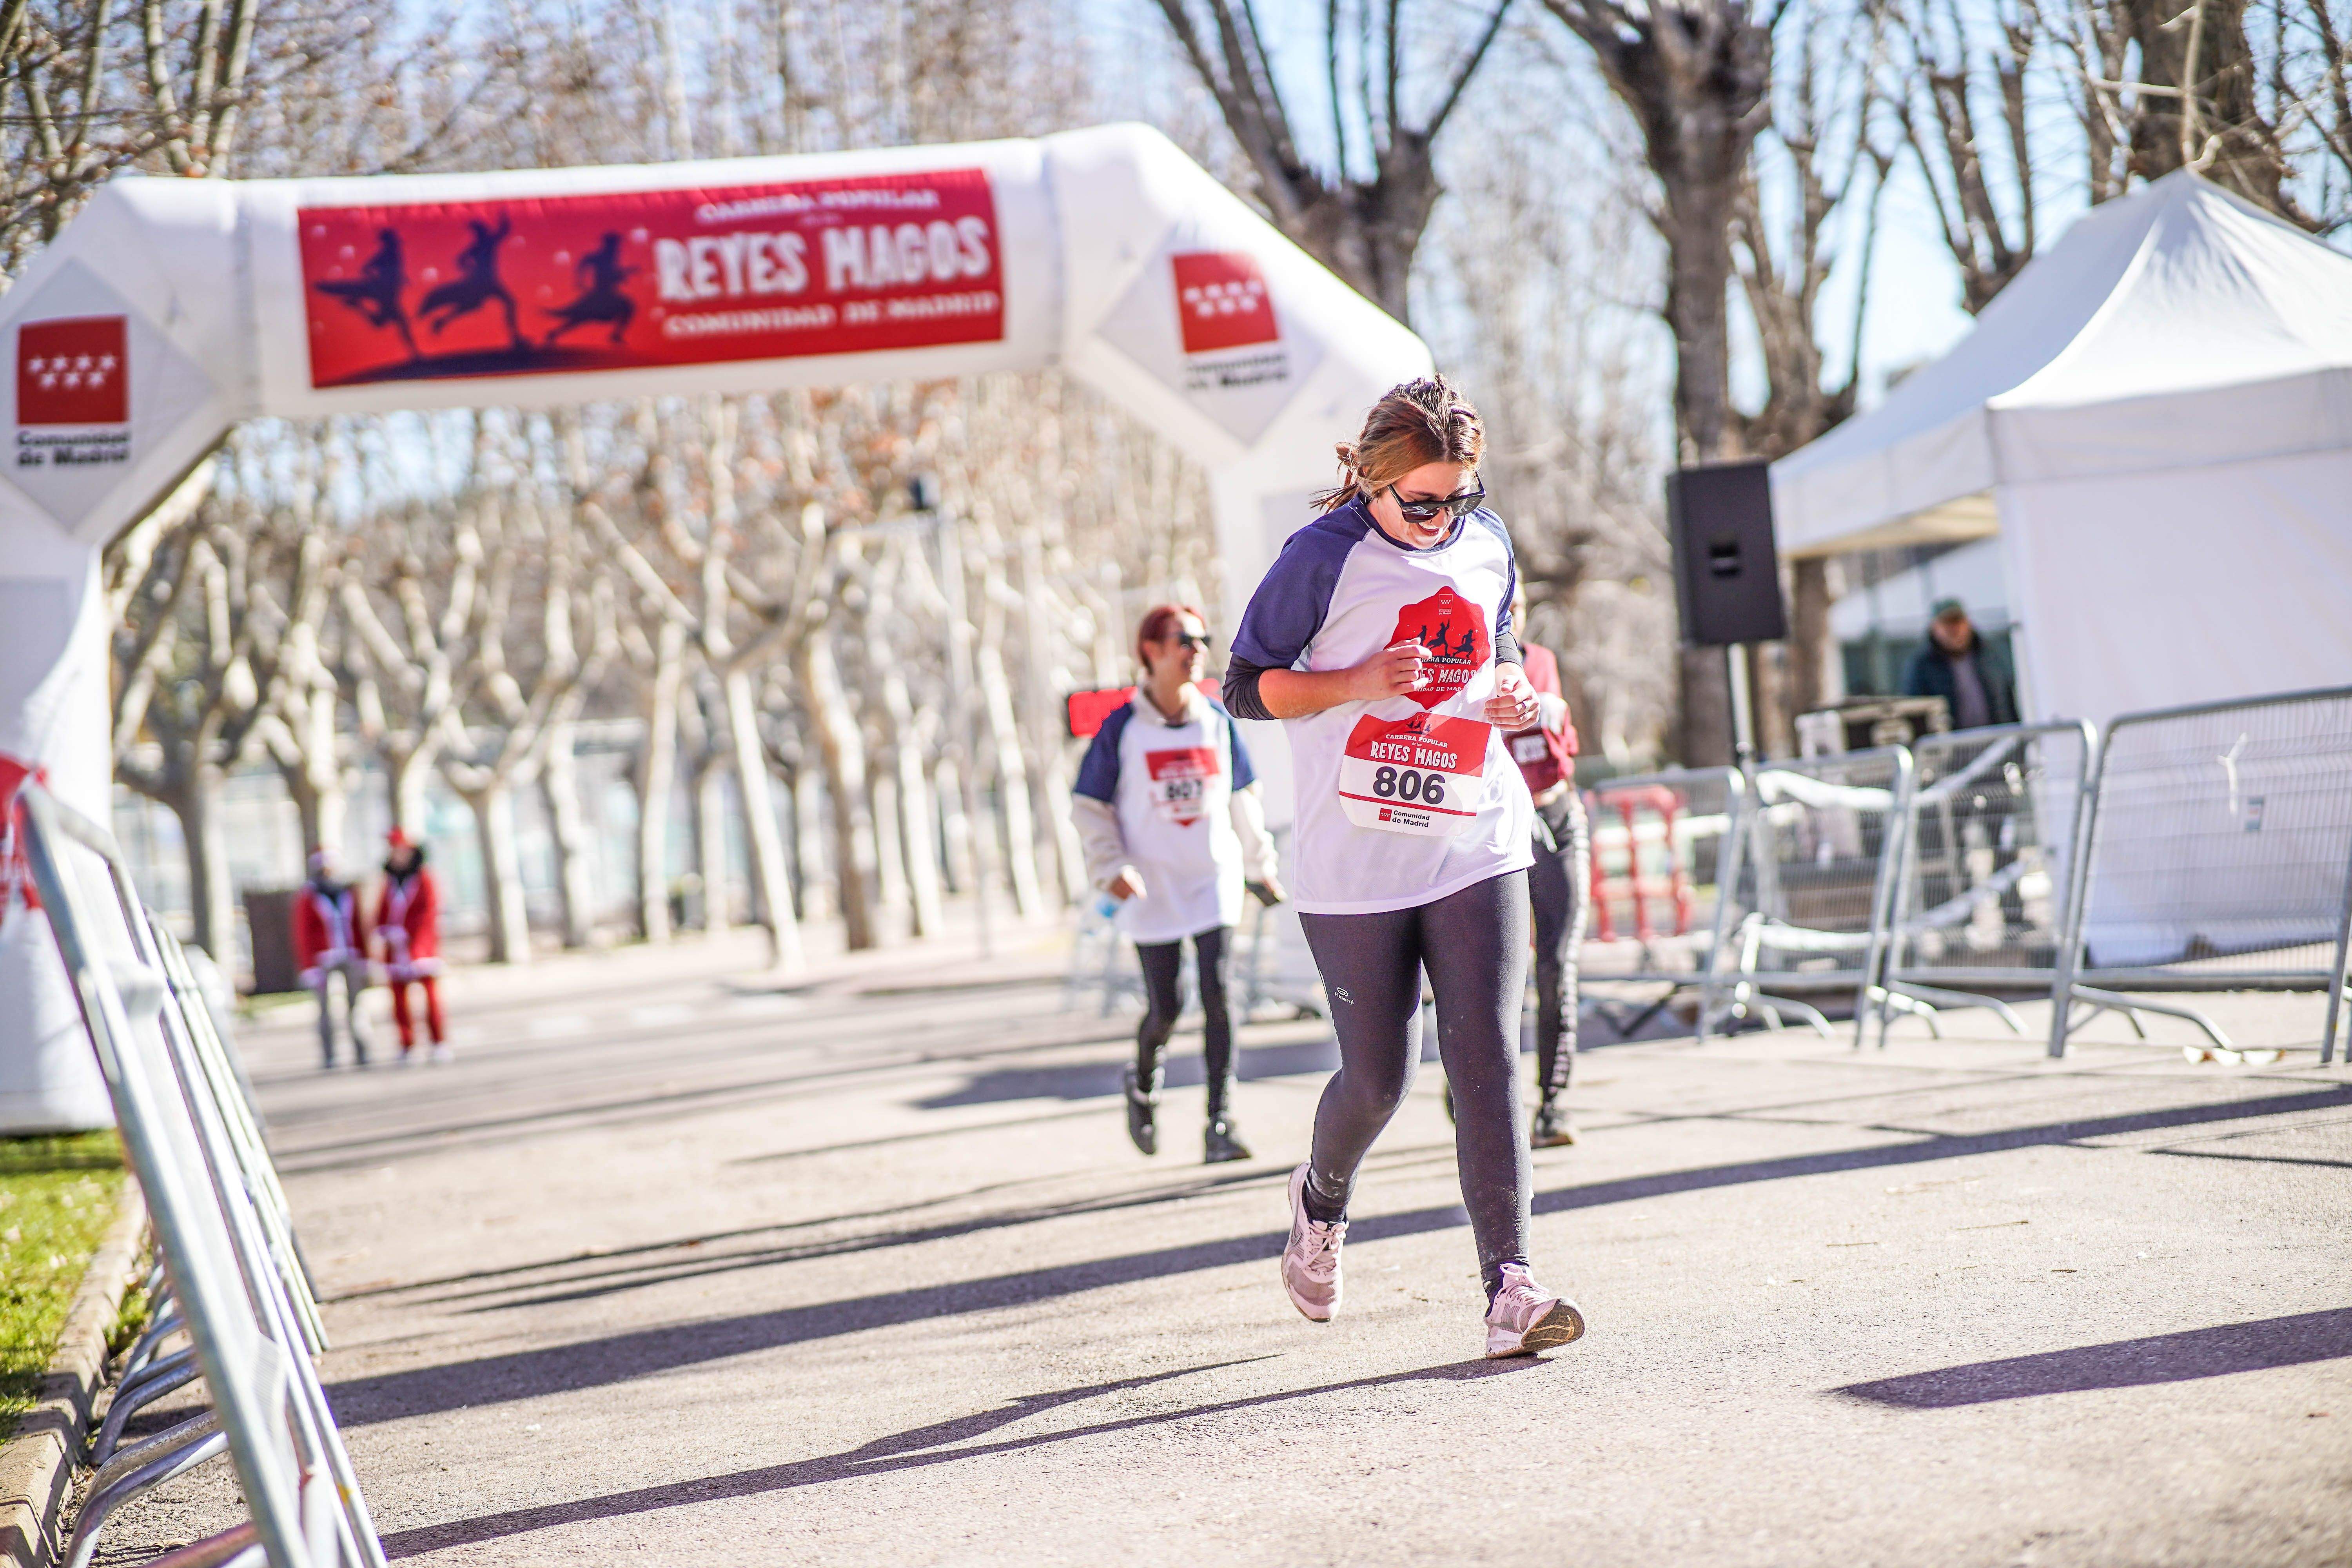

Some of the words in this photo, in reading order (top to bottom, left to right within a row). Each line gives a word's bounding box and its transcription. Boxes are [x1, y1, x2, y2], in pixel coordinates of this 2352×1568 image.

[654, 231, 808, 301] REYES
[822, 216, 989, 291] MAGOS
[663, 303, 836, 336] COMUNIDAD
[843, 300, 878, 323] DE
[887, 291, 996, 318] MADRID
[17, 430, 129, 446] Comunidad
[54, 446, 129, 463] Madrid
[1418, 737, 1448, 748] POPULAR
[1370, 741, 1410, 762] REYES
[1414, 748, 1457, 769] MAGOS
[1373, 766, 1445, 804] 806
[1394, 810, 1430, 820] Comunidad
[1403, 818, 1429, 828] Madrid
